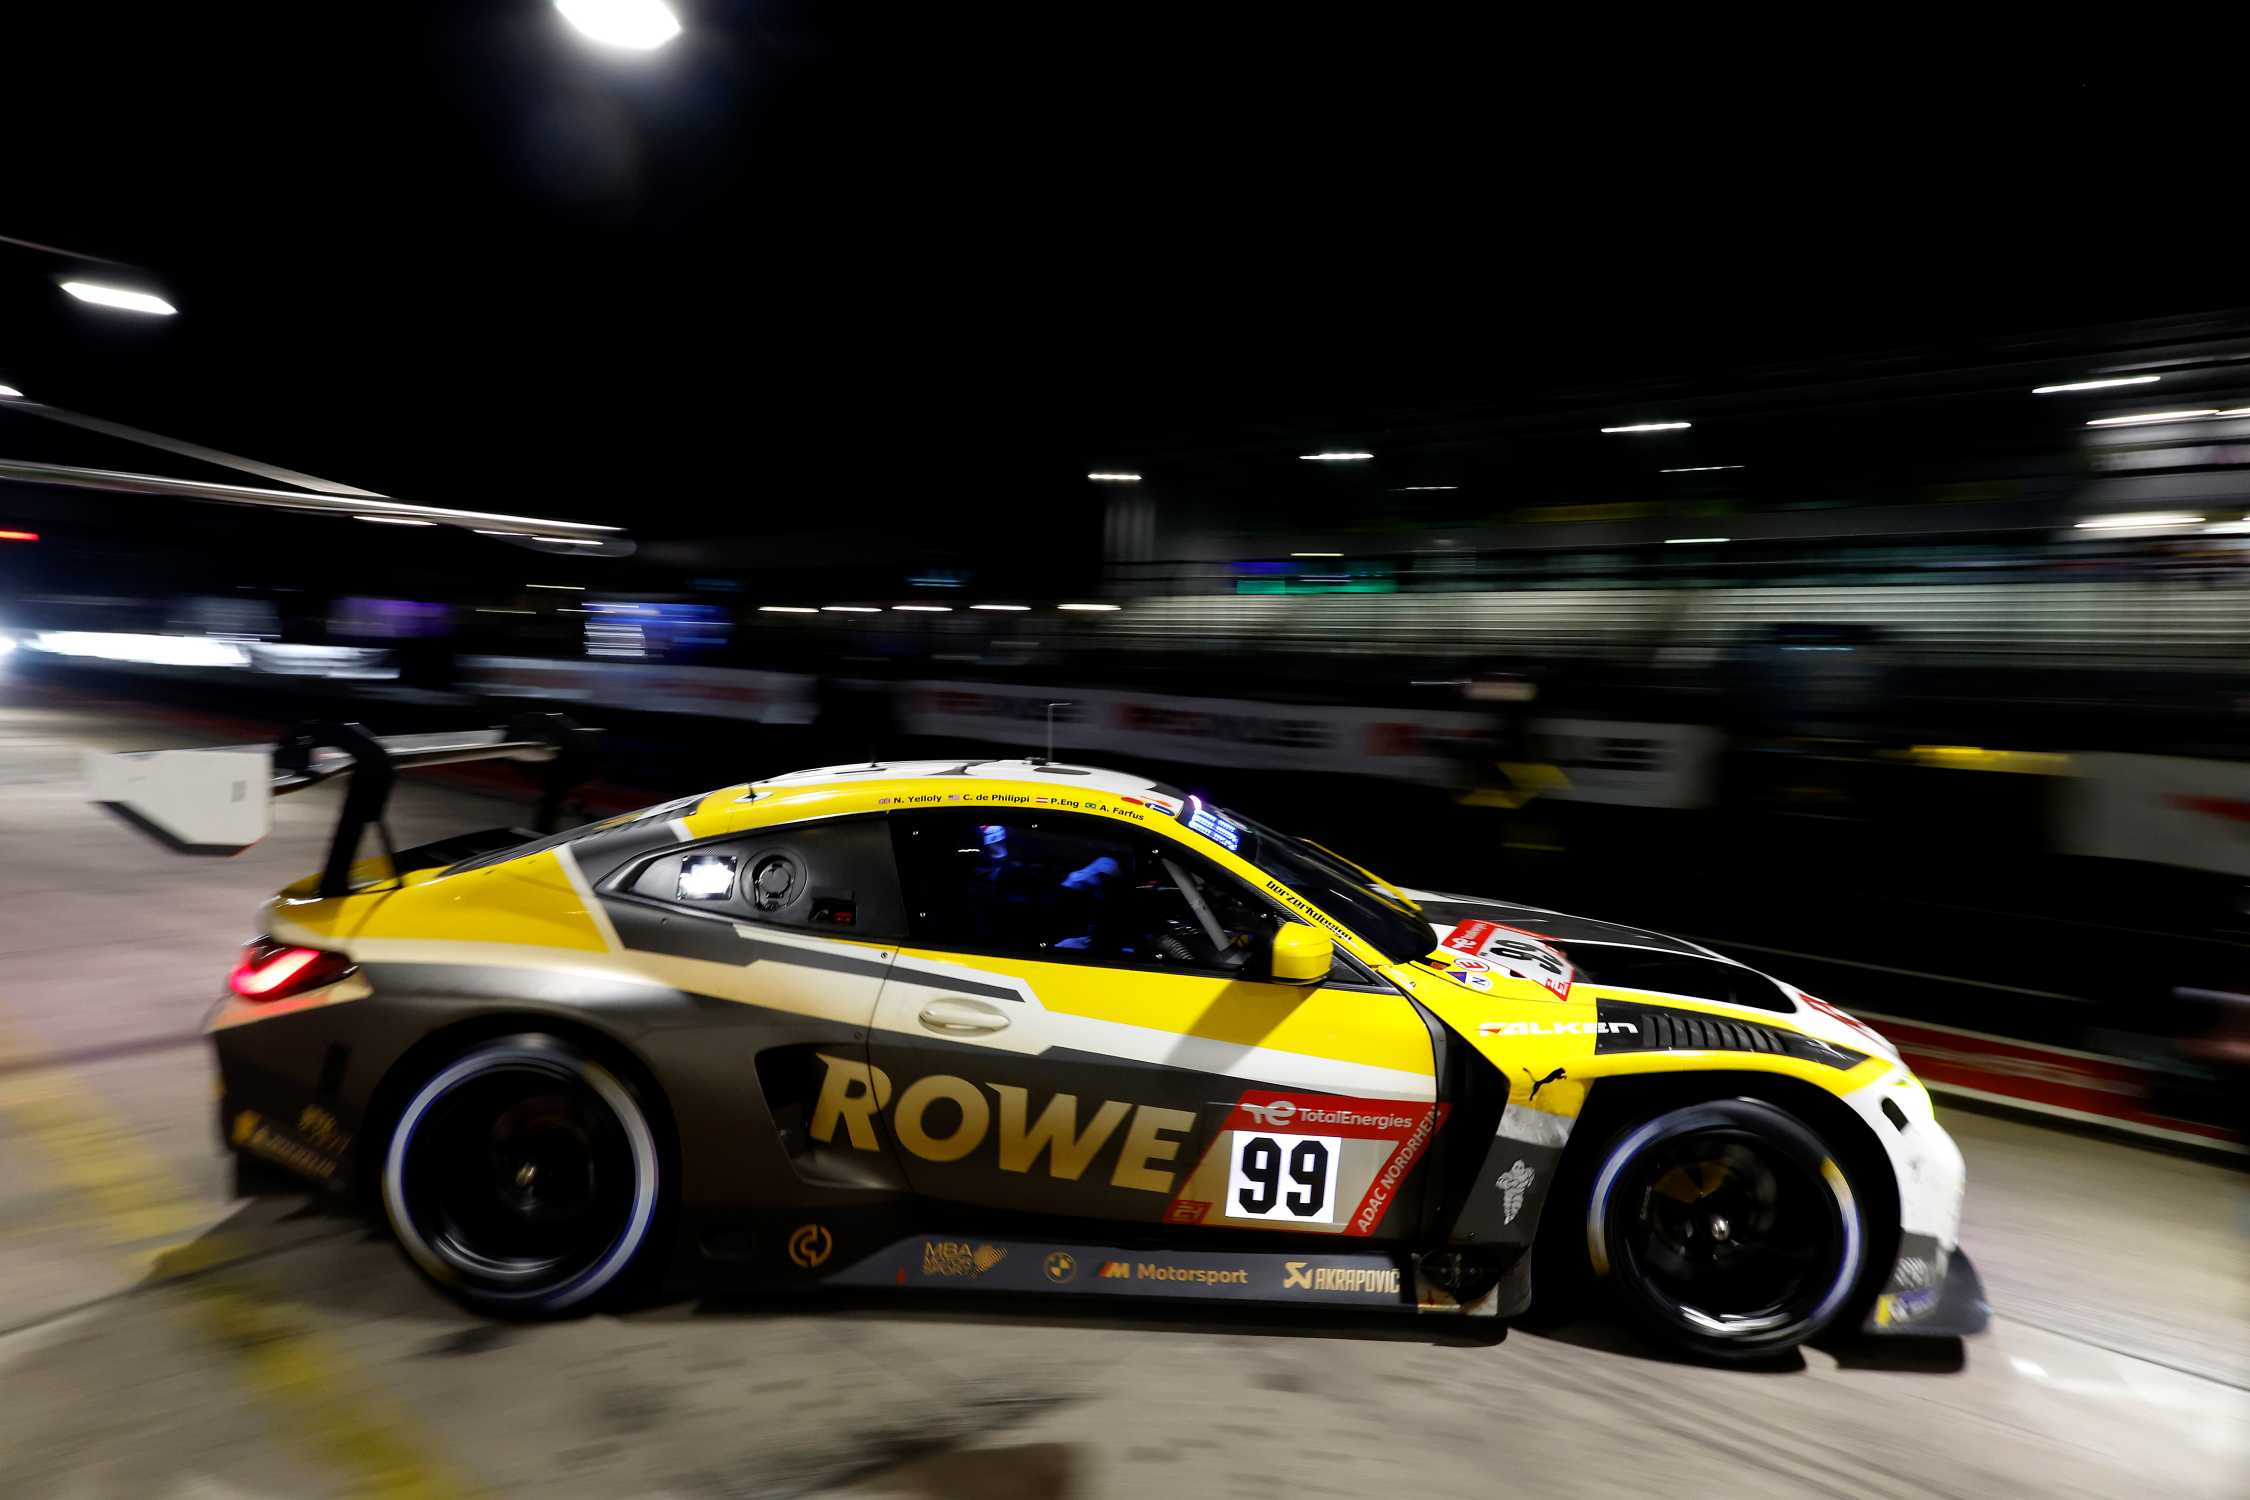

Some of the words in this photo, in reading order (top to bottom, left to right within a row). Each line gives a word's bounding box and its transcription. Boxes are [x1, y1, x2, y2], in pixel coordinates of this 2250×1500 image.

[908, 794, 943, 803] Yelloly
[962, 793, 973, 801] C.
[976, 793, 989, 801] de
[991, 794, 1030, 804] Philippi
[1099, 804, 1109, 813] A.
[1112, 807, 1145, 821] Farfus
[809, 1052, 1197, 1194] ROWE
[1299, 1108, 1413, 1130] TotalEnergies
[1238, 1136, 1329, 1217] 99
[1358, 1187, 1388, 1232] ADAC
[1137, 1263, 1249, 1285] Motorsport
